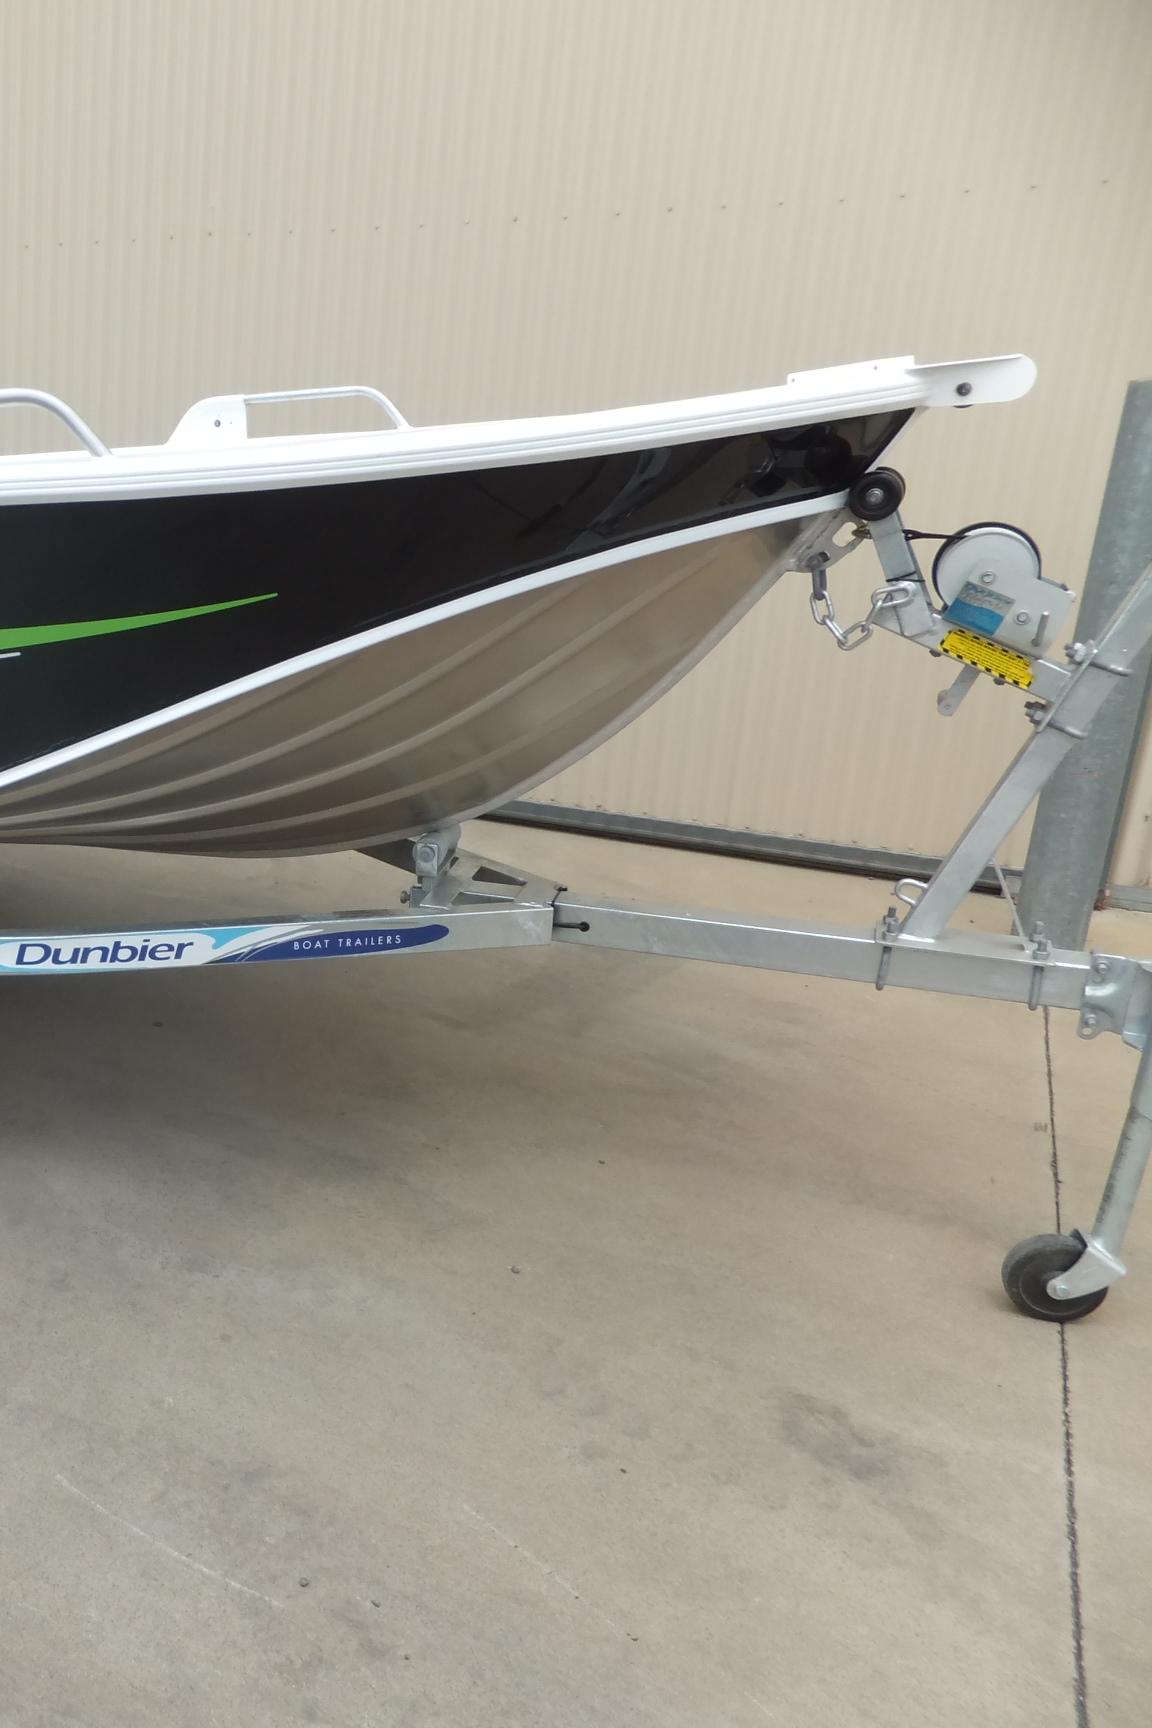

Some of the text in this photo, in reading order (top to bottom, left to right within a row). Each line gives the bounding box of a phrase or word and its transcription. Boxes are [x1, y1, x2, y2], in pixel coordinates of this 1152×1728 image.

[15, 935, 402, 966] Dunbier BOAT TRAILERS
